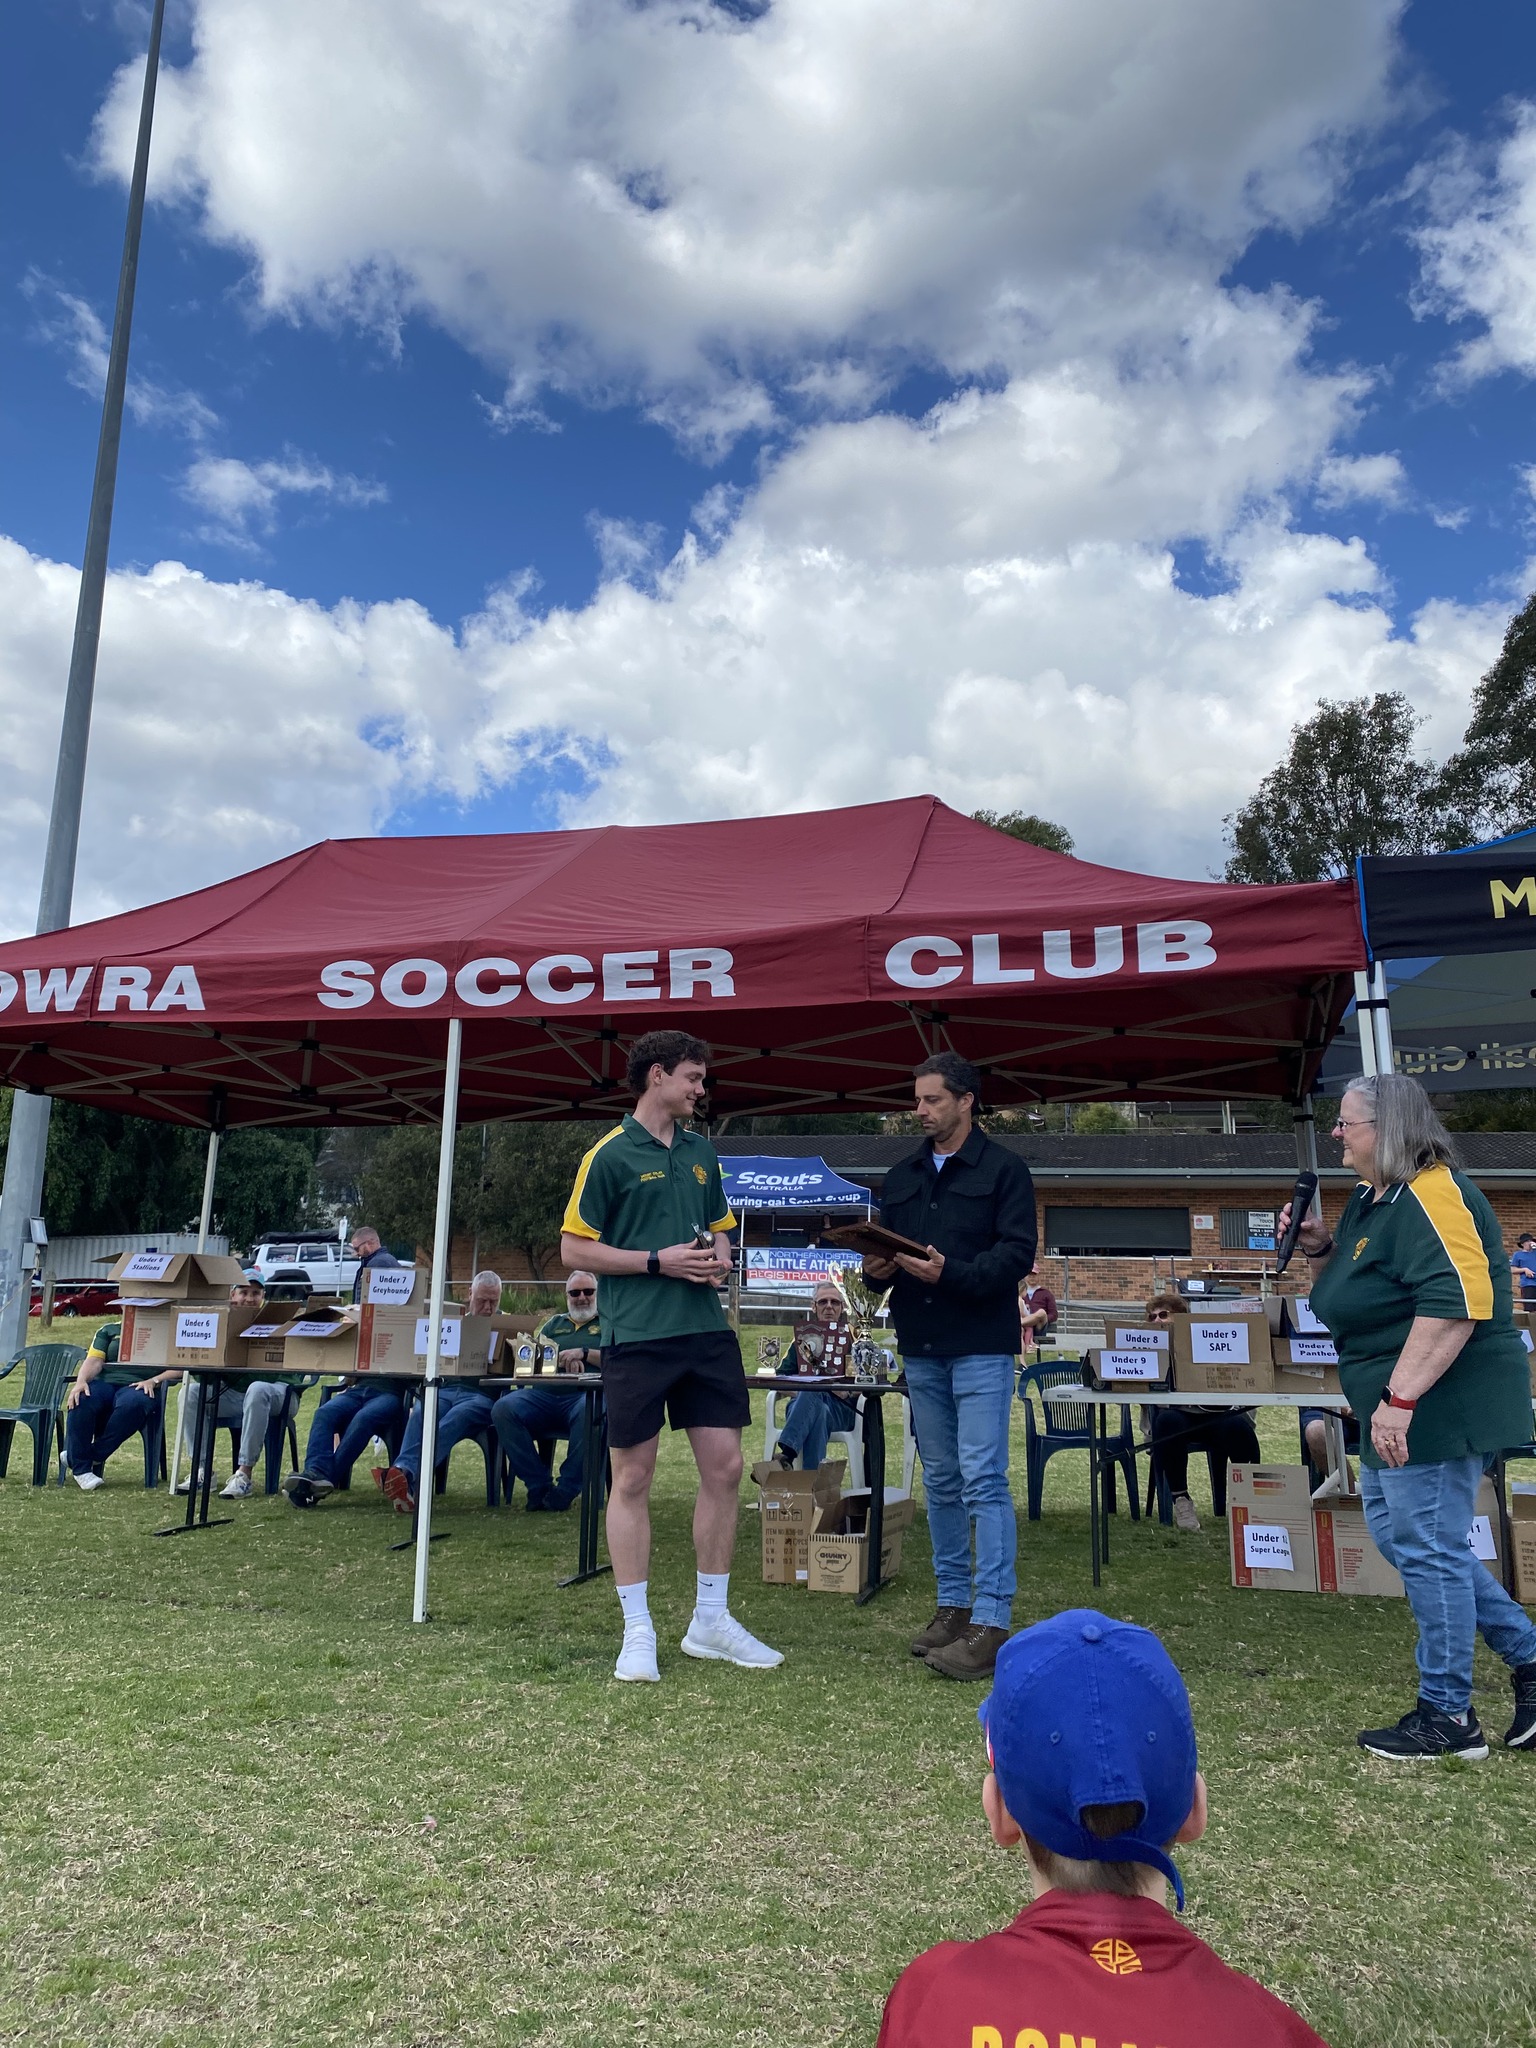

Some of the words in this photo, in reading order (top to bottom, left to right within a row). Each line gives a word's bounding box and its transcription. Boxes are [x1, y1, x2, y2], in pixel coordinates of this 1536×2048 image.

[317, 948, 737, 1009] SOCCER
[885, 920, 1217, 989] CLUB
[736, 1171, 823, 1186] Scouts
[748, 1184, 804, 1192] AUSTRALIA
[769, 1251, 824, 1259] NORTHERN
[769, 1258, 806, 1270] LITTLE
[379, 1275, 400, 1284] Under
[401, 1276, 407, 1284] 7
[372, 1286, 410, 1296] Greyhounds
[185, 1319, 204, 1327] Under
[205, 1319, 210, 1327] 6
[446, 1325, 452, 1333] 8
[181, 1330, 211, 1340] Mustangs
[1125, 1334, 1150, 1344] Under
[1152, 1335, 1159, 1344] 8
[1202, 1330, 1225, 1339] Under
[1231, 1330, 1237, 1339] 9
[1209, 1342, 1232, 1352] SAPL
[1111, 1356, 1138, 1364] Under
[1140, 1357, 1147, 1365] 9
[1115, 1367, 1144, 1375] Hawks
[1252, 1532, 1280, 1543] Under
[1250, 1545, 1271, 1554] Super
